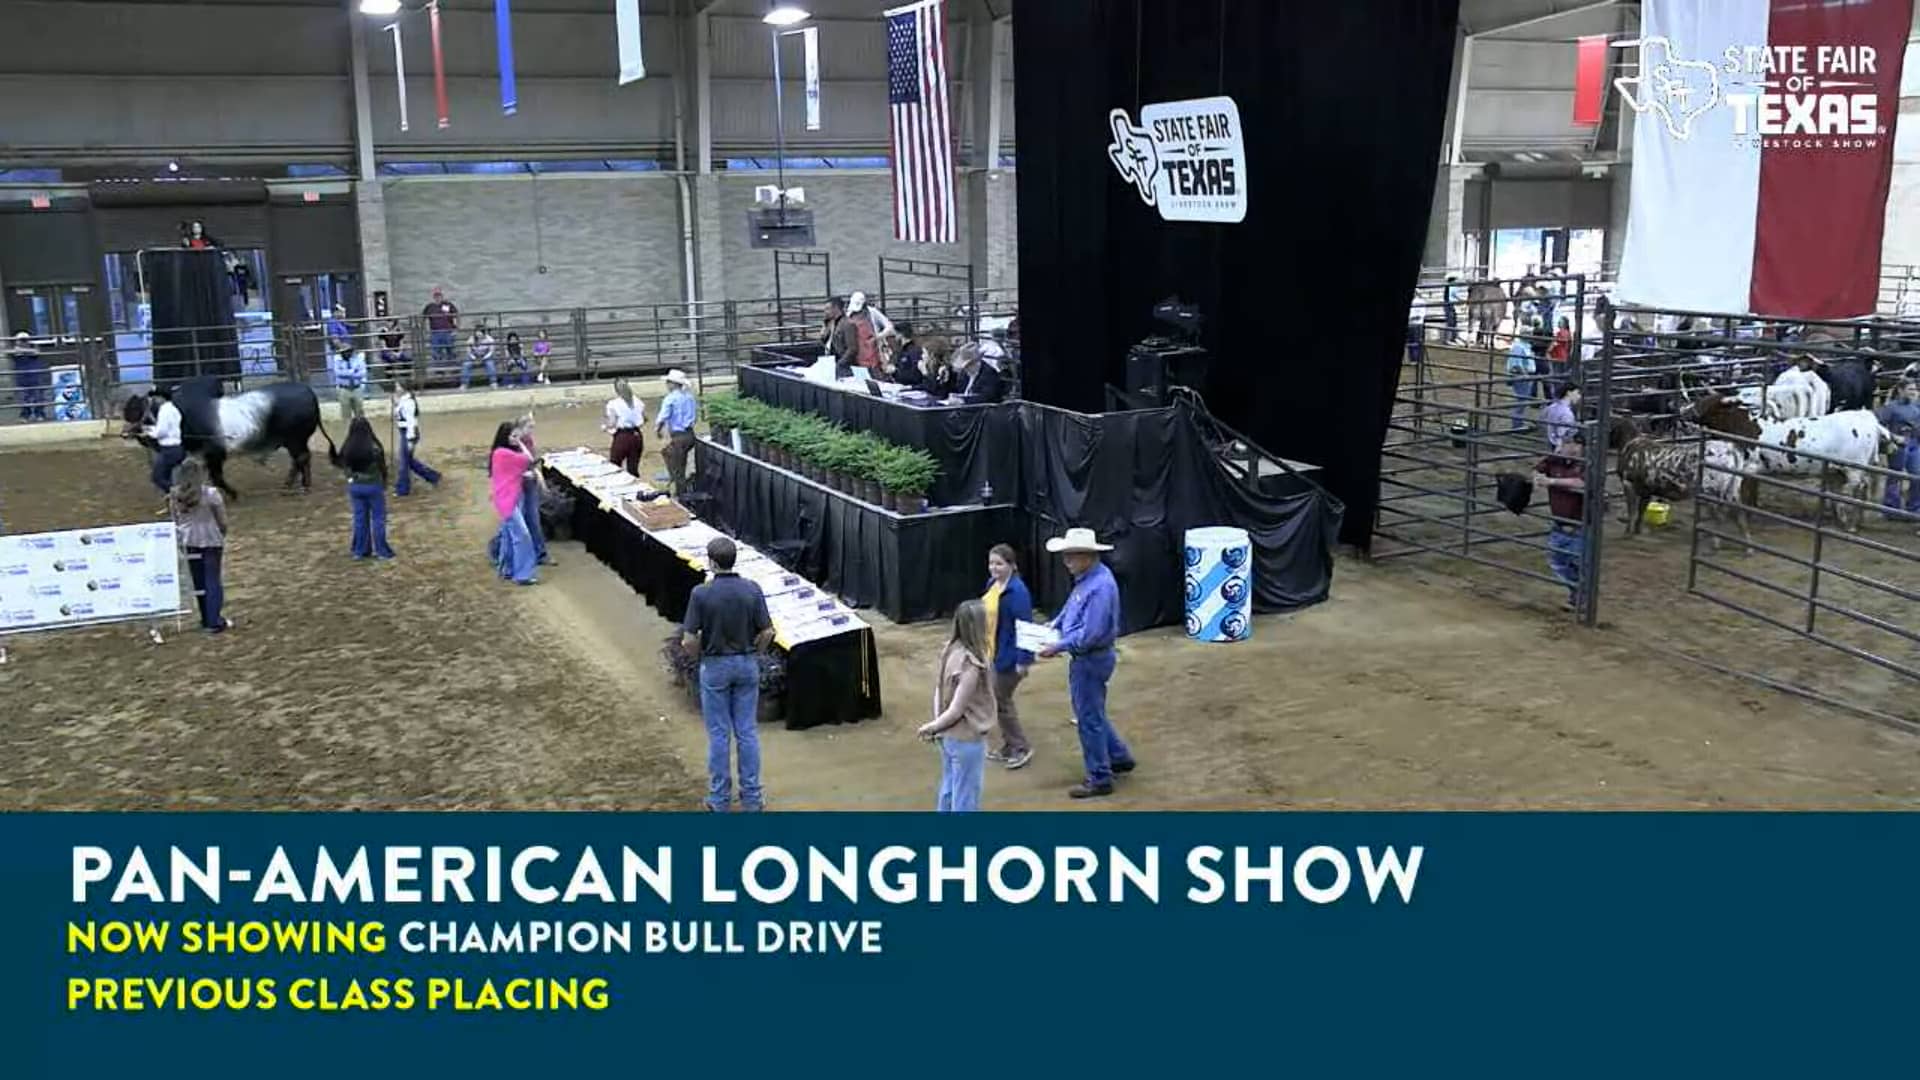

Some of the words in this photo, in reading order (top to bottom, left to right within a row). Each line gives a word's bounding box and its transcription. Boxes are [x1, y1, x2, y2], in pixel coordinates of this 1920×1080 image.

[1153, 115, 1197, 143] STATE
[1197, 113, 1232, 140] FAIR
[1187, 144, 1201, 157] OF
[1162, 158, 1236, 196] TEXAS
